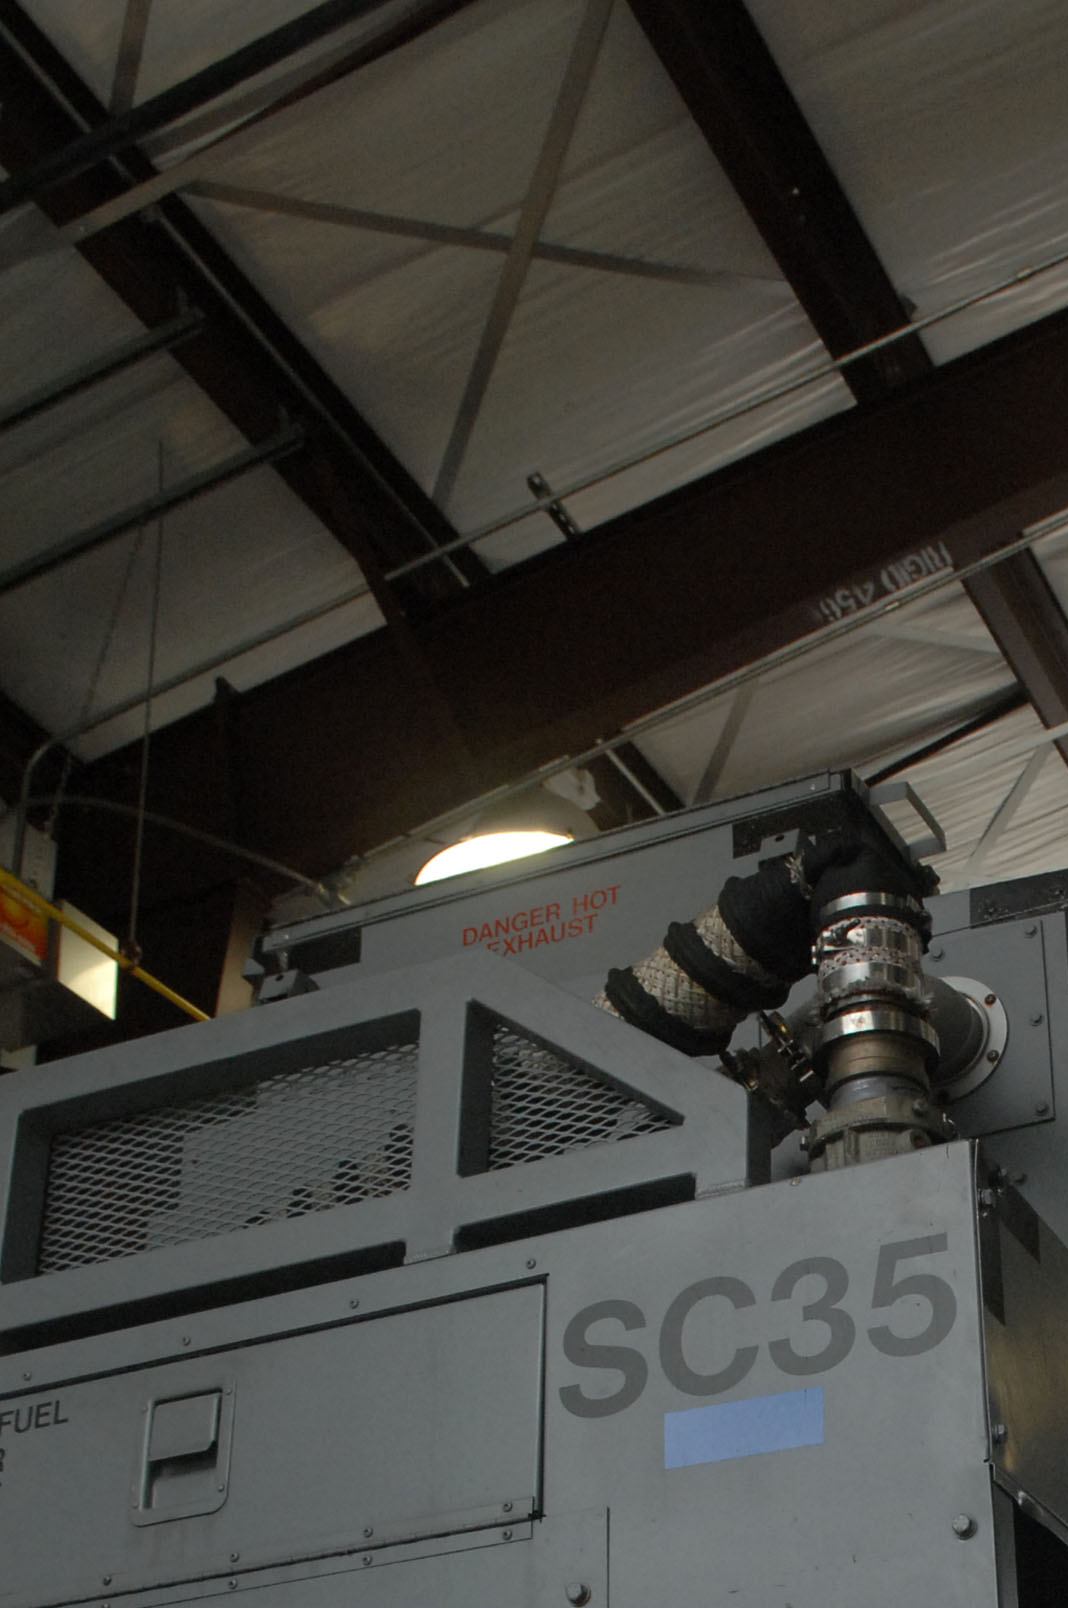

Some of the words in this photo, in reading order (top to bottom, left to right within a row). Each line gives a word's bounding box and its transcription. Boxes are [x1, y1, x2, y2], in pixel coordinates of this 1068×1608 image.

[461, 902, 561, 947] DANGER
[572, 884, 622, 915] HOT
[558, 1232, 957, 1419] SC35
[0, 1400, 69, 1436] FUEL
